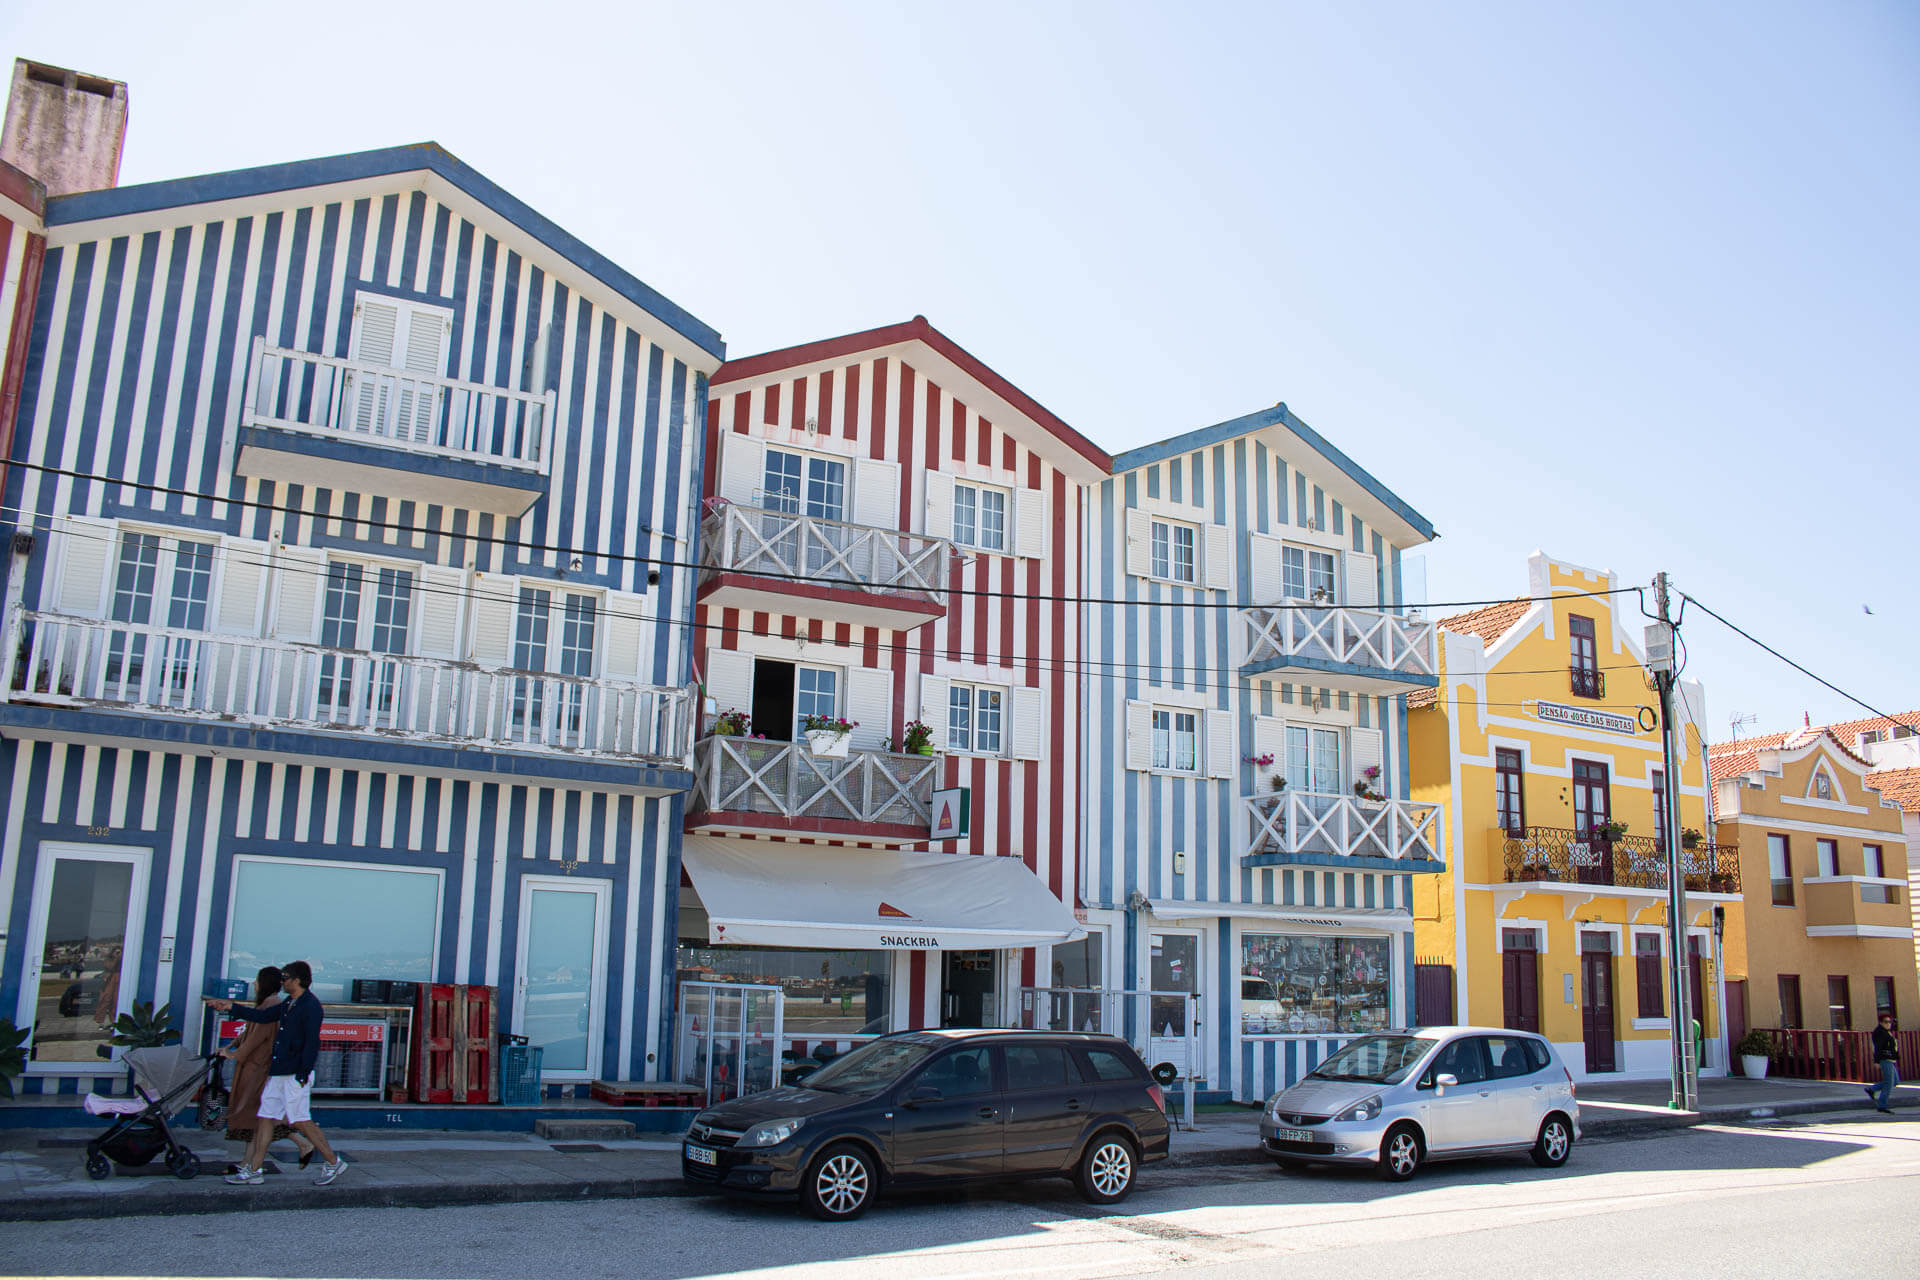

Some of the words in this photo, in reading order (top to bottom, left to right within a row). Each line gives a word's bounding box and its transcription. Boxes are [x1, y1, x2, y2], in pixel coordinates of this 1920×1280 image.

[1540, 706, 1568, 719] PENSÃO
[1590, 715, 1604, 726] DAS
[880, 935, 939, 947] SNACKRIA
